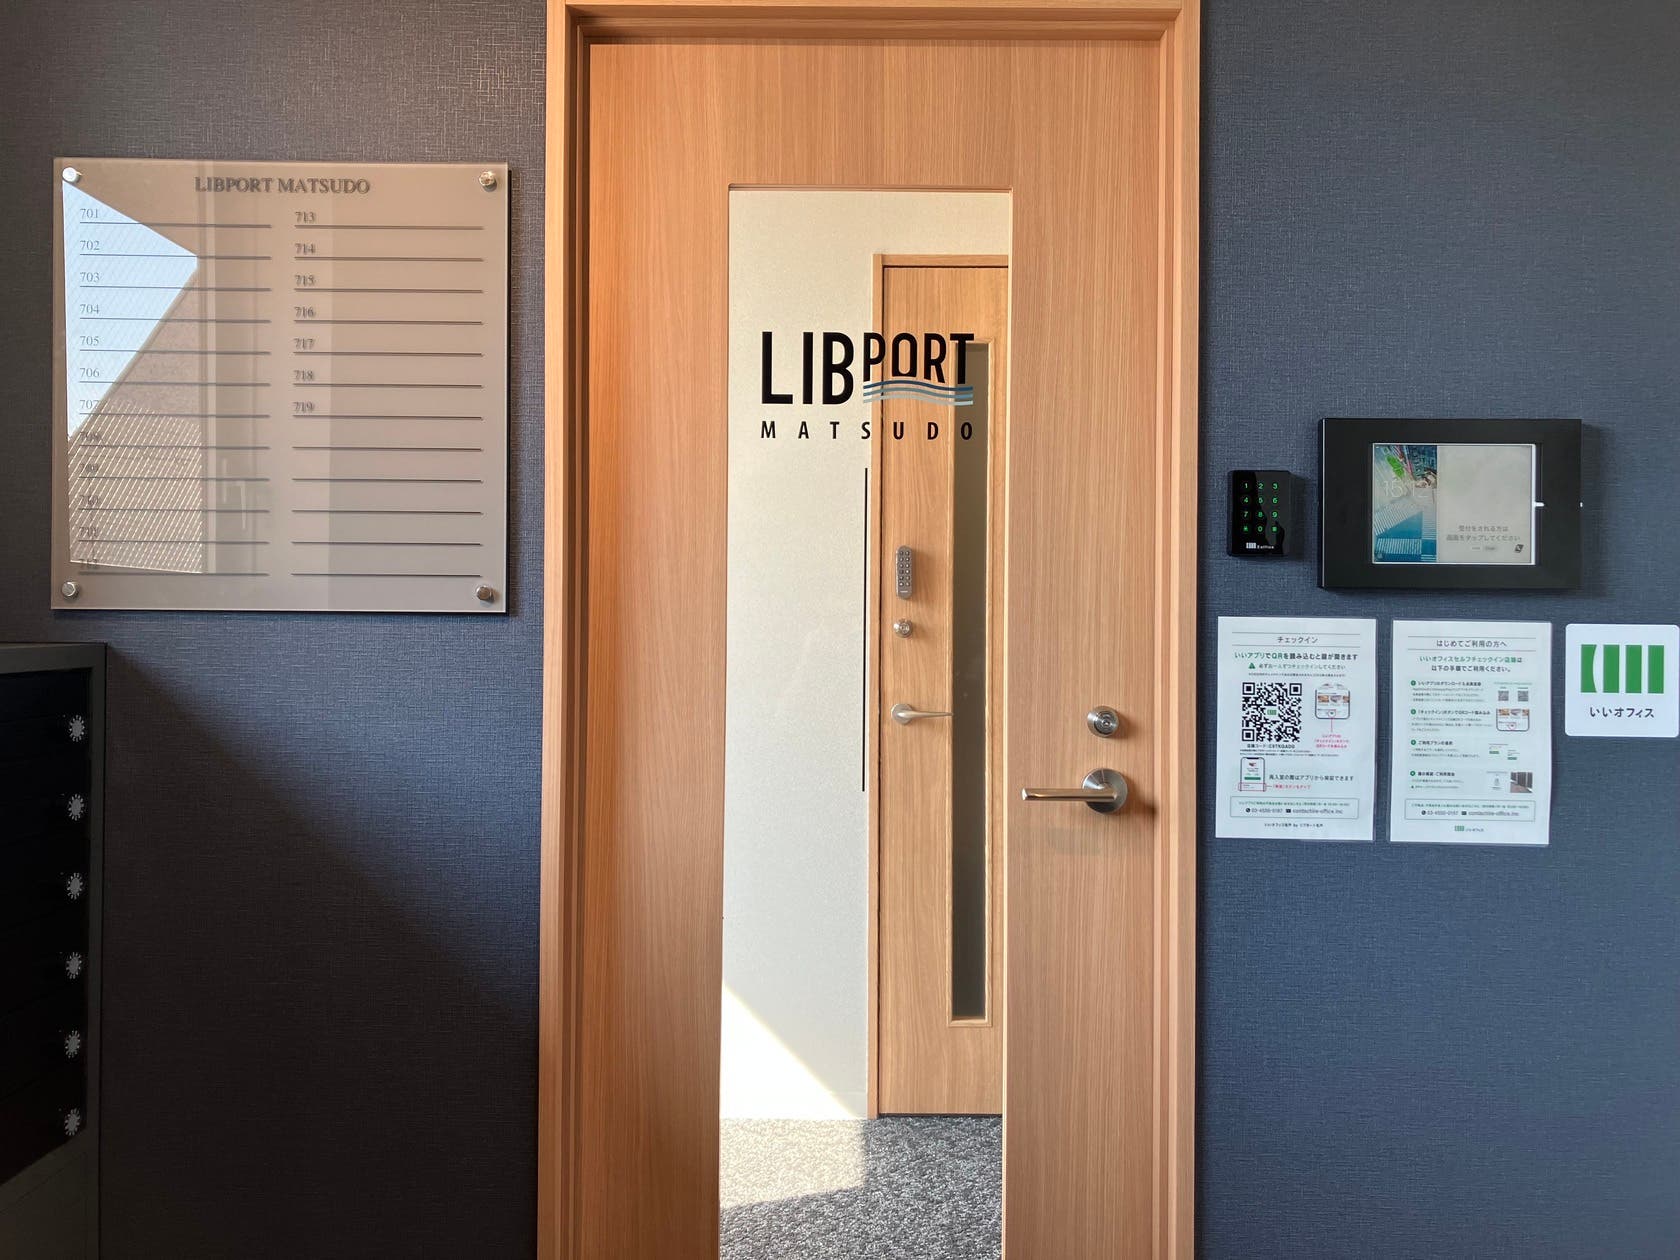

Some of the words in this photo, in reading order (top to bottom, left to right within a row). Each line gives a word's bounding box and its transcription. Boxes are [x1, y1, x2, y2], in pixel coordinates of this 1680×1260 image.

[195, 176, 272, 194] LIBPORT
[278, 177, 371, 195] MATSUDO
[79, 208, 100, 220] 701
[294, 211, 316, 223] 713
[79, 240, 100, 251] 702
[294, 243, 316, 255] 714
[79, 272, 100, 283] 703
[294, 274, 316, 286] 715
[79, 303, 100, 315] 704
[294, 306, 315, 318] 716
[79, 335, 100, 346] 705
[294, 338, 315, 350] 717
[79, 367, 100, 378] 706
[762, 331, 975, 405] LIBPORT
[293, 370, 315, 381] 718
[79, 399, 100, 410] 707
[293, 401, 315, 413] 719
[761, 420, 974, 441] MATSUDO
[1277, 636, 1318, 644] チェックイン
[1436, 639, 1508, 648] はじめてご利用の方へ
[1589, 706, 1655, 719] いいオフィス
